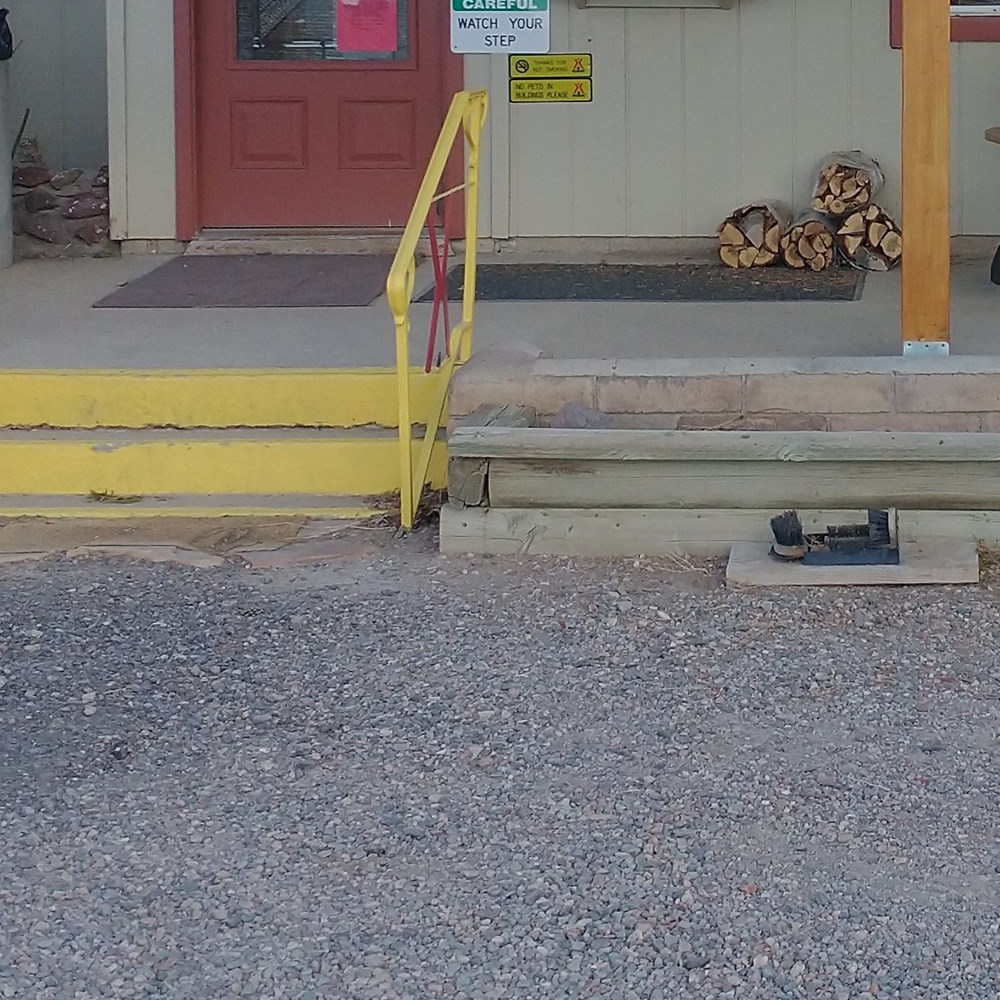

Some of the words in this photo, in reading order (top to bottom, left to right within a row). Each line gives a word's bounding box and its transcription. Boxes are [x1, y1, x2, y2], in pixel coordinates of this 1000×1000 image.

[458, 18, 498, 29] WATCH
[509, 17, 543, 29] YOUR
[484, 35, 516, 46] STEP
